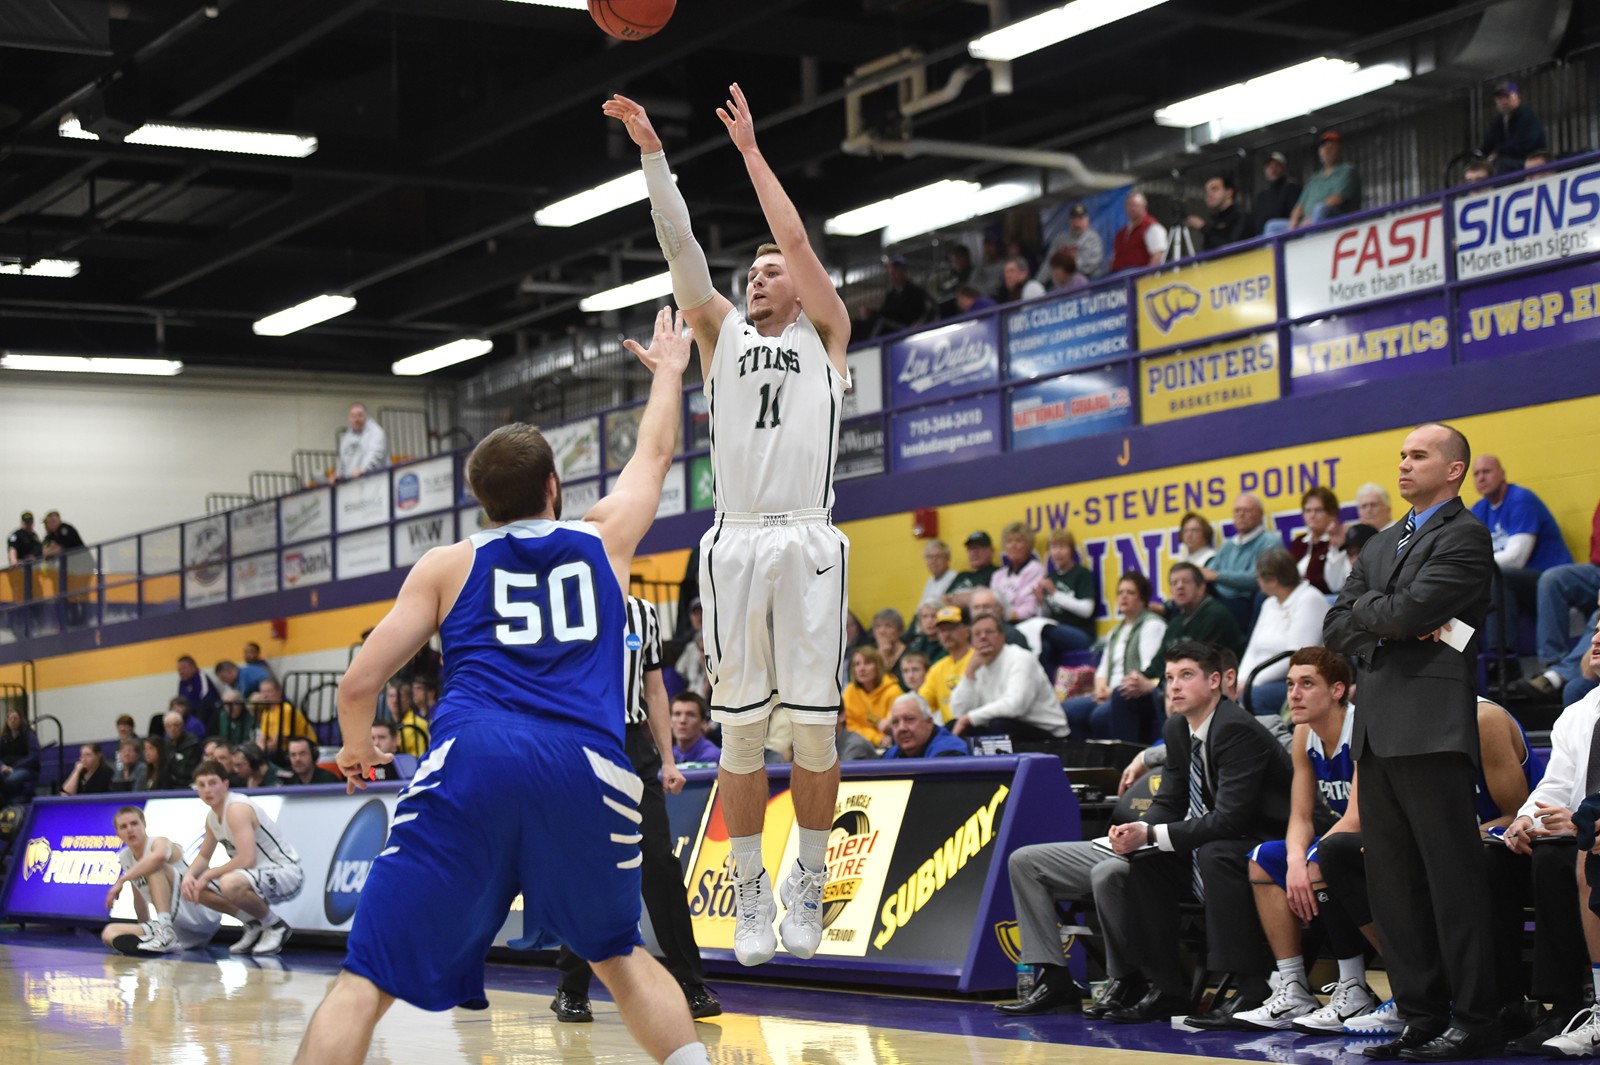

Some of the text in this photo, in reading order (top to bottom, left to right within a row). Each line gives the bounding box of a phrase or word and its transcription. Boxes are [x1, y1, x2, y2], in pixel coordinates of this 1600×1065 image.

[1459, 170, 1600, 251] SIGNS
[1331, 209, 1443, 281] FAST
[1460, 251, 1502, 274] More
[1505, 239, 1543, 266] than
[1210, 275, 1271, 310] UWSP
[1329, 283, 1367, 303] More
[1371, 272, 1405, 296] than
[1030, 301, 1080, 329] COLLEGE
[1081, 289, 1128, 316] TUITION
[1066, 335, 1129, 362] PAYCHECK
[1291, 316, 1449, 379] ATHLETICS
[1147, 343, 1275, 396] POINTERS
[755, 383, 781, 429] 11
[1013, 401, 1067, 431] NATIONAL
[1070, 394, 1110, 417] GUARD
[1169, 384, 1253, 413] BASKETBALL
[1116, 438, 1130, 468] J
[1025, 457, 1342, 535] UW-STEVENS POINT
[763, 513, 788, 527] IWU
[492, 560, 598, 645] 50
[828, 857, 867, 882] TIRE
[873, 784, 1010, 951] SUBWAY
[689, 869, 737, 918] Sto
